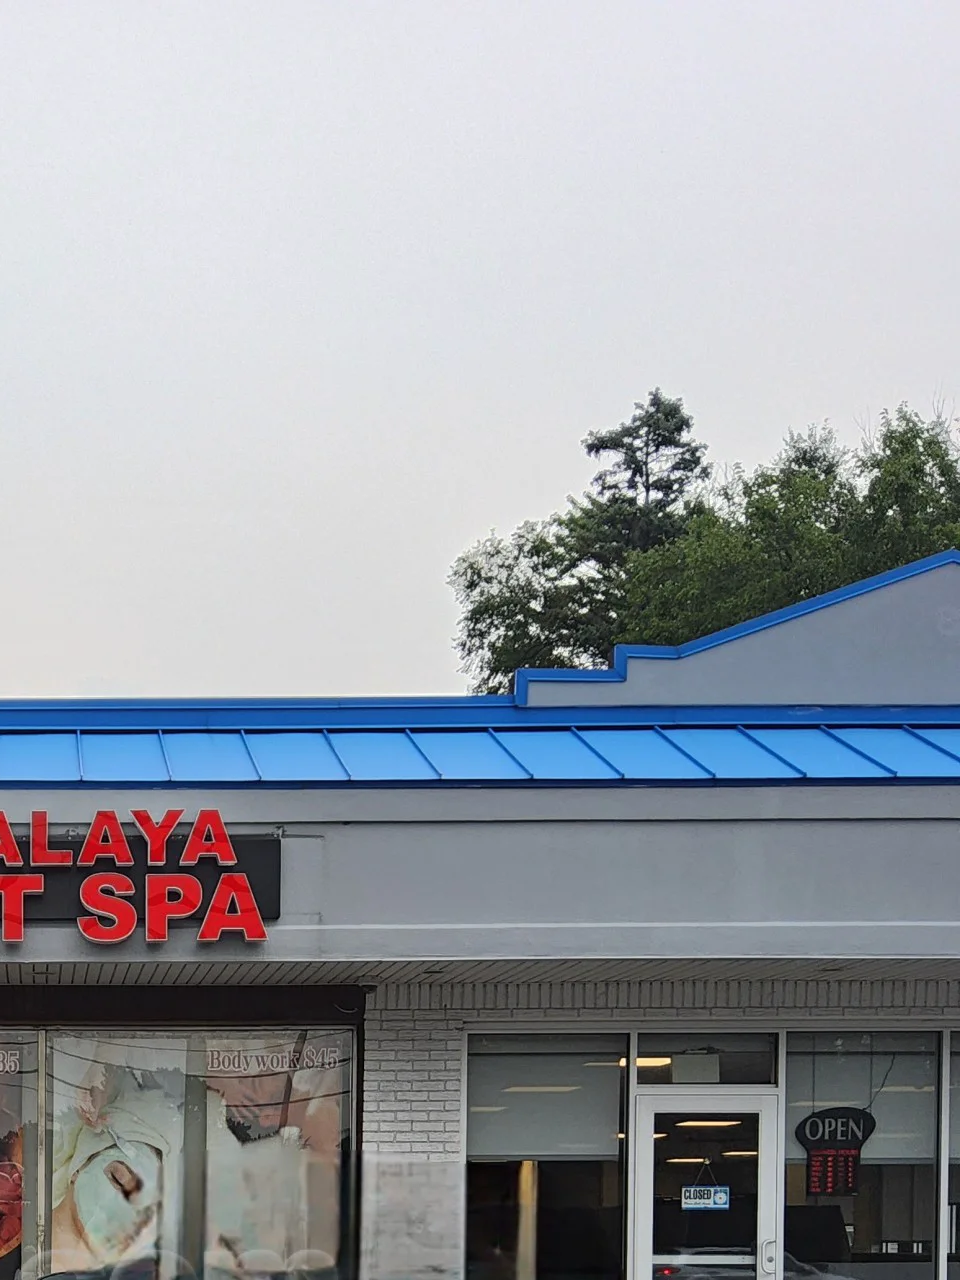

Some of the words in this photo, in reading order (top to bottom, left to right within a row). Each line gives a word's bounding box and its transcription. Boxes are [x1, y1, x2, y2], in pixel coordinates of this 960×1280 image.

[76, 872, 268, 945] SPA
[208, 1048, 300, 1073] Bodywork
[304, 1046, 339, 1071] $45
[805, 1117, 864, 1140] OPEN
[684, 1189, 712, 1200] CLOSED
